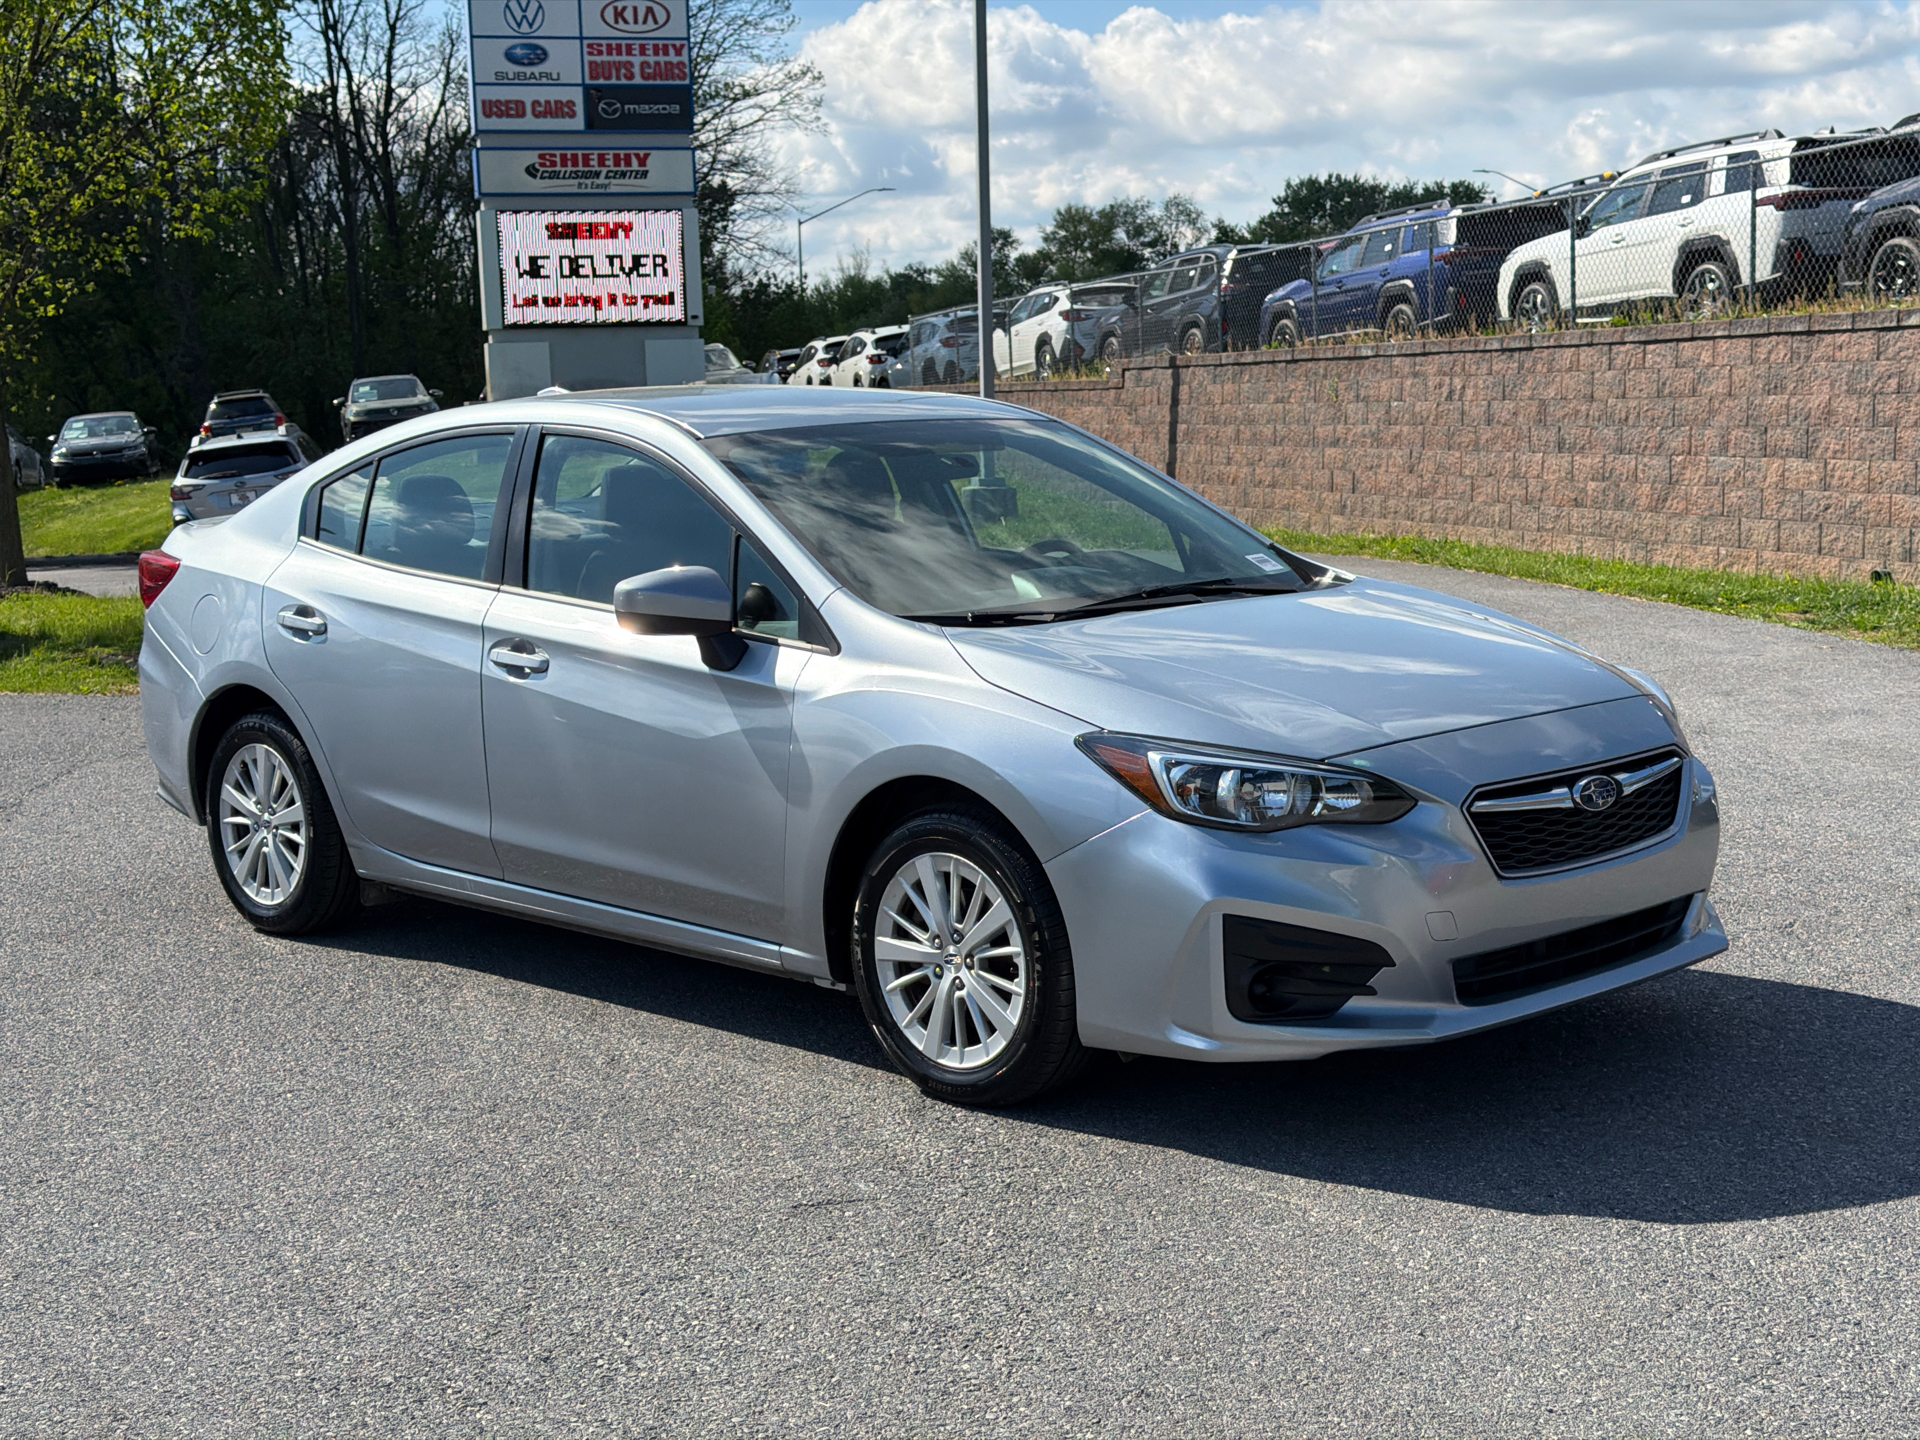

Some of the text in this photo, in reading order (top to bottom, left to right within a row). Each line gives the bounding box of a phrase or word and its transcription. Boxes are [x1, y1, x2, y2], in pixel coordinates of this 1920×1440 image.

[613, 6, 660, 25] KIA
[586, 43, 686, 57] SHEEHY
[494, 71, 561, 81] SUBARU
[588, 61, 687, 81] BUYS CARS
[481, 99, 577, 119] USED CARS
[537, 153, 651, 168] SHEEHY
[539, 169, 650, 181] COLLISION CENTER
[577, 181, 612, 191] It's Easy!
[515, 254, 668, 278] WE DELIVER
